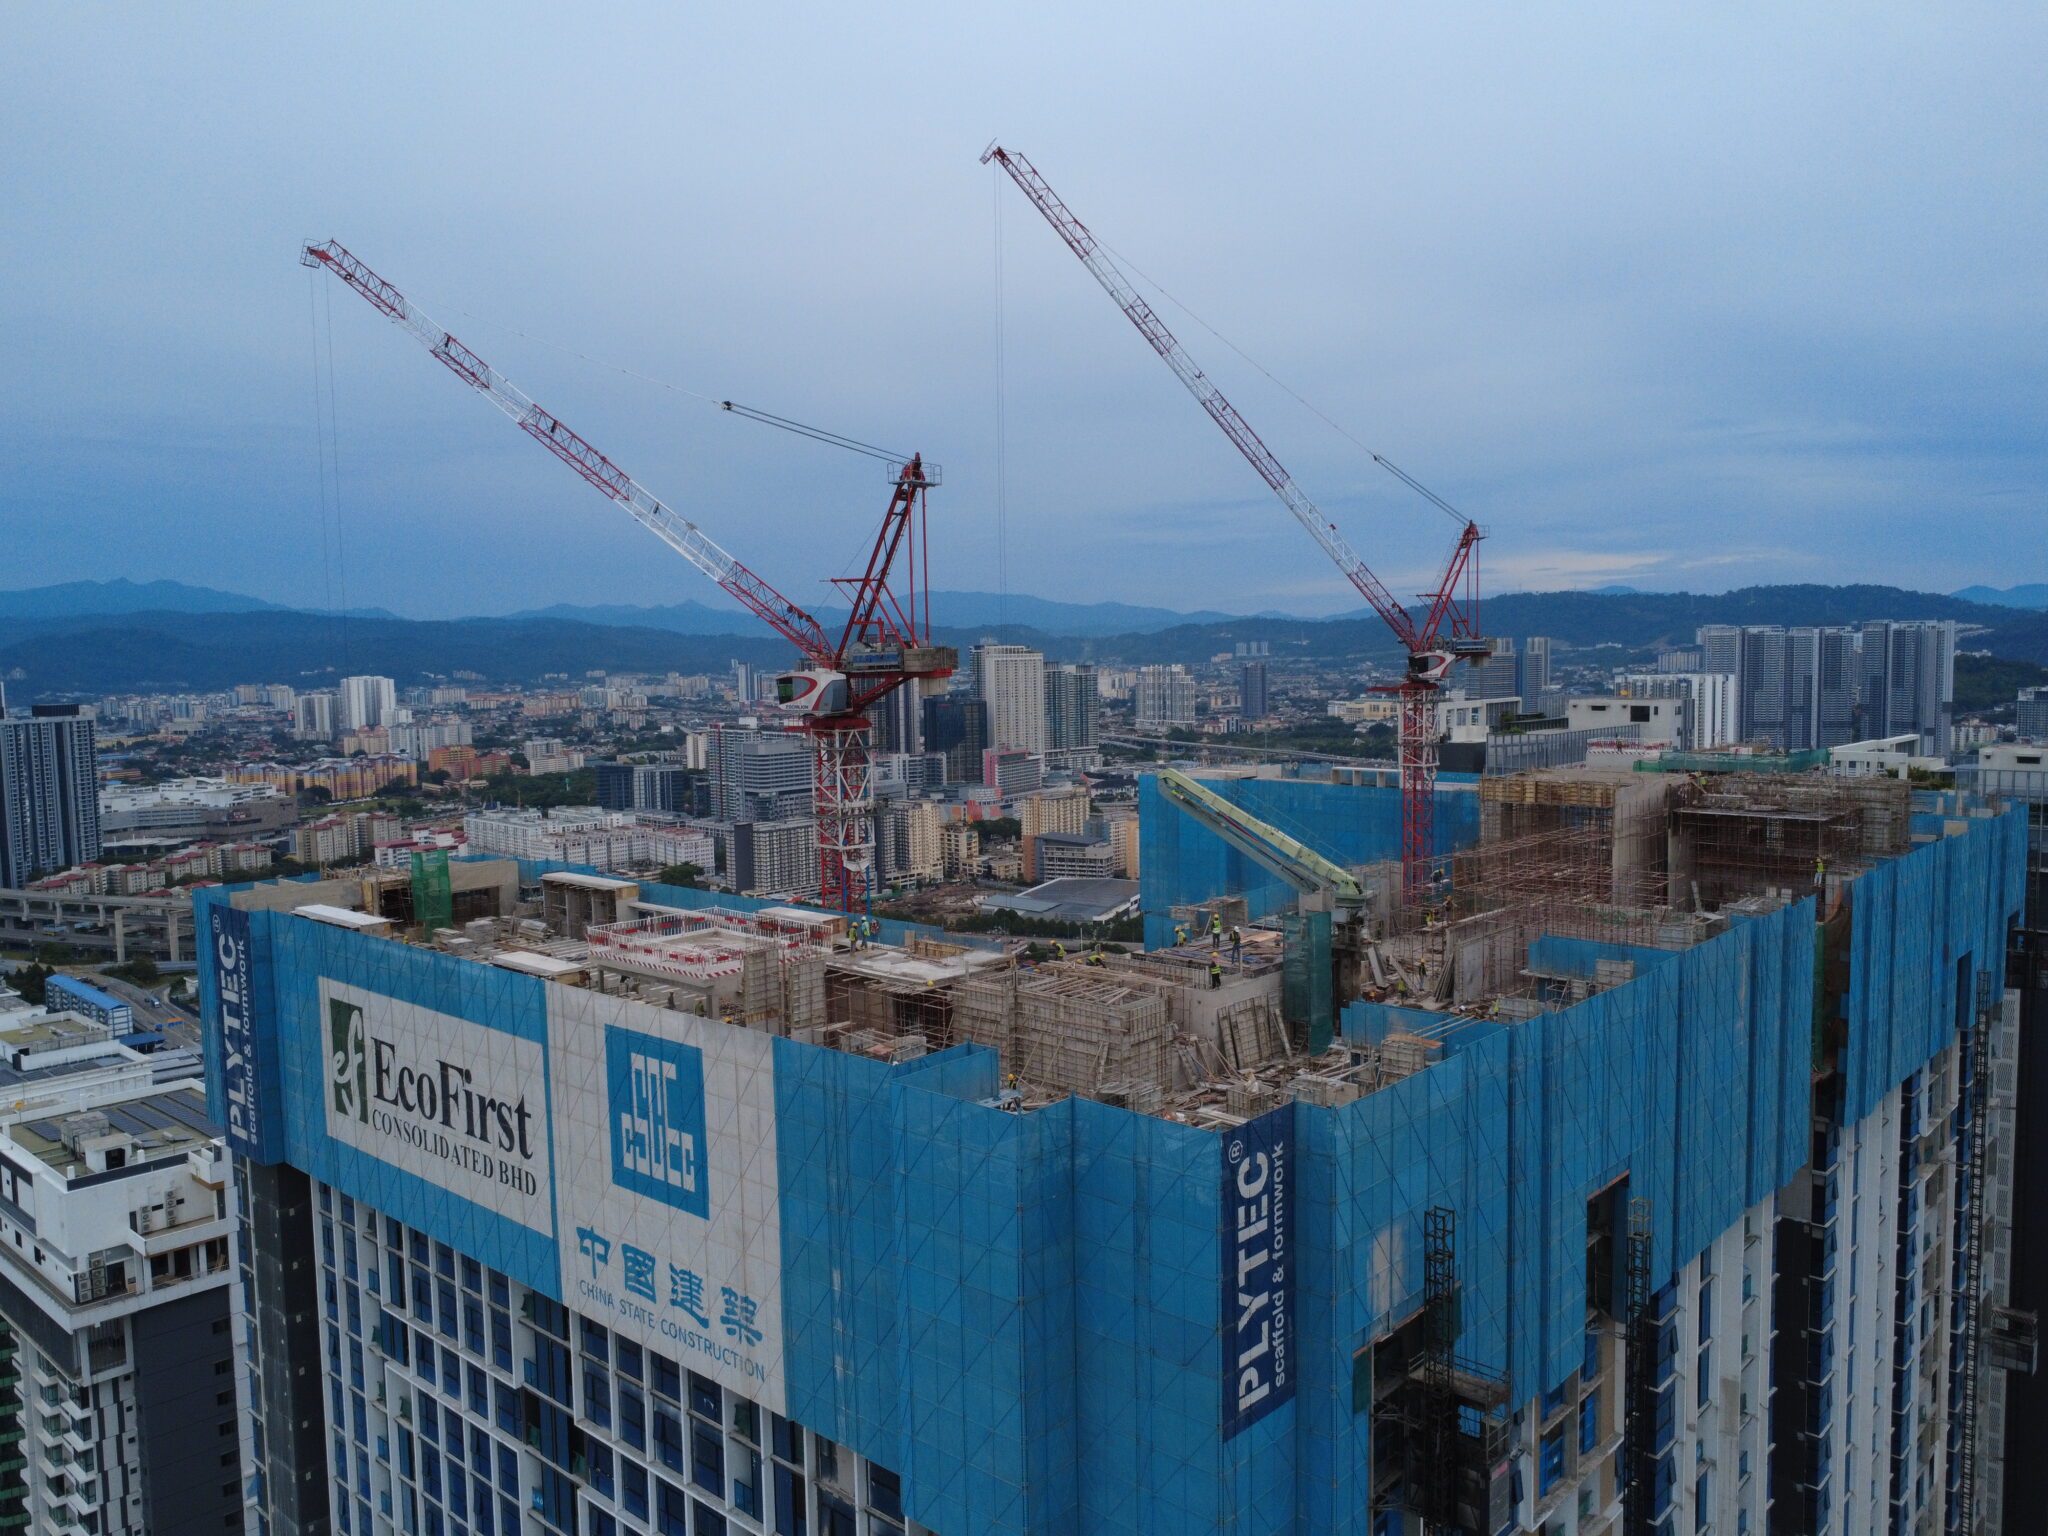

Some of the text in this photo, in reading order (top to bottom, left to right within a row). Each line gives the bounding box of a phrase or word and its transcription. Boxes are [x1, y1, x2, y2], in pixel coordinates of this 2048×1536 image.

[218, 932, 249, 1142] PLYTEC
[236, 939, 258, 1146] scaffold & formwork
[370, 1036, 534, 1160] EcoFirst
[372, 1109, 537, 1197] CONSOLIDATED BHD
[579, 1279, 766, 1383] CHINA STATE CONSTRUCTION
[1237, 1150, 1270, 1412] PLYTEC
[1271, 1140, 1285, 1388] scaffold & formwork
